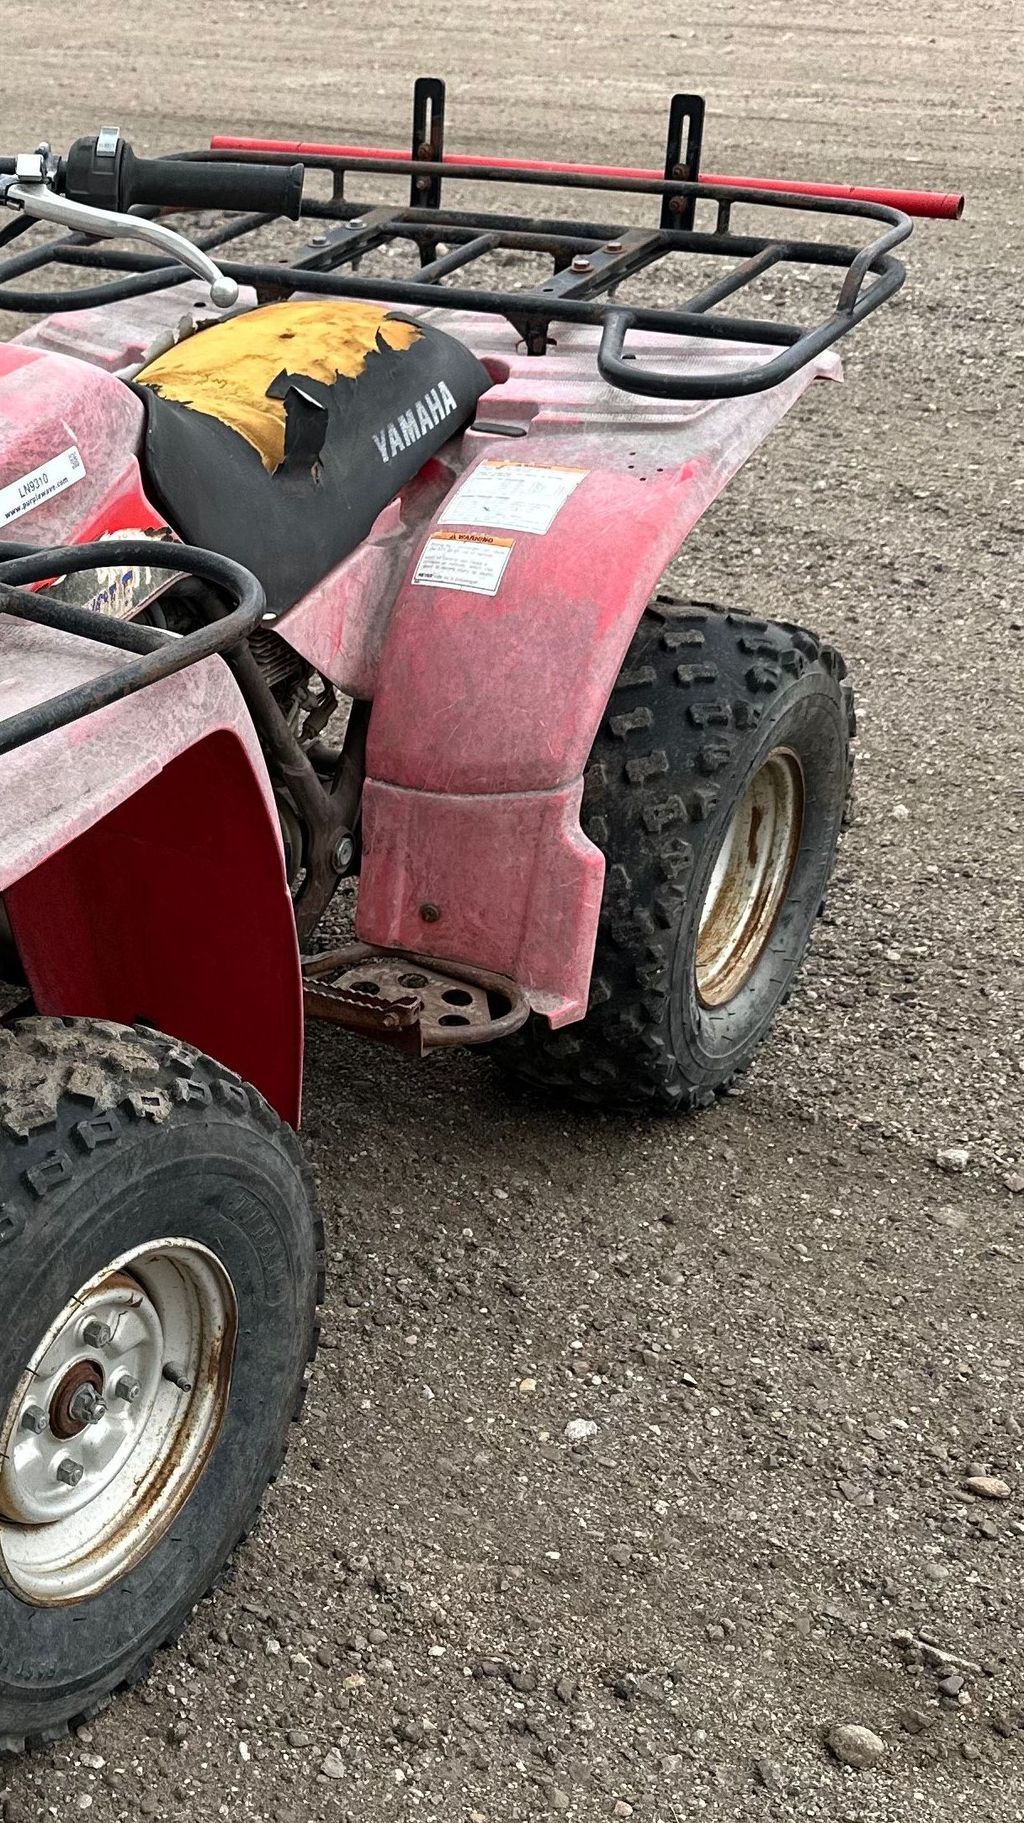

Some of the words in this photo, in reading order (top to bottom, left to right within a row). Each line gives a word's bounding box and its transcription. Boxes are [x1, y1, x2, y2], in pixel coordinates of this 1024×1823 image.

[371, 380, 457, 463] YAMAHA
[4, 476, 69, 519] www.purplewave.com
[19, 473, 49, 498] LN9310
